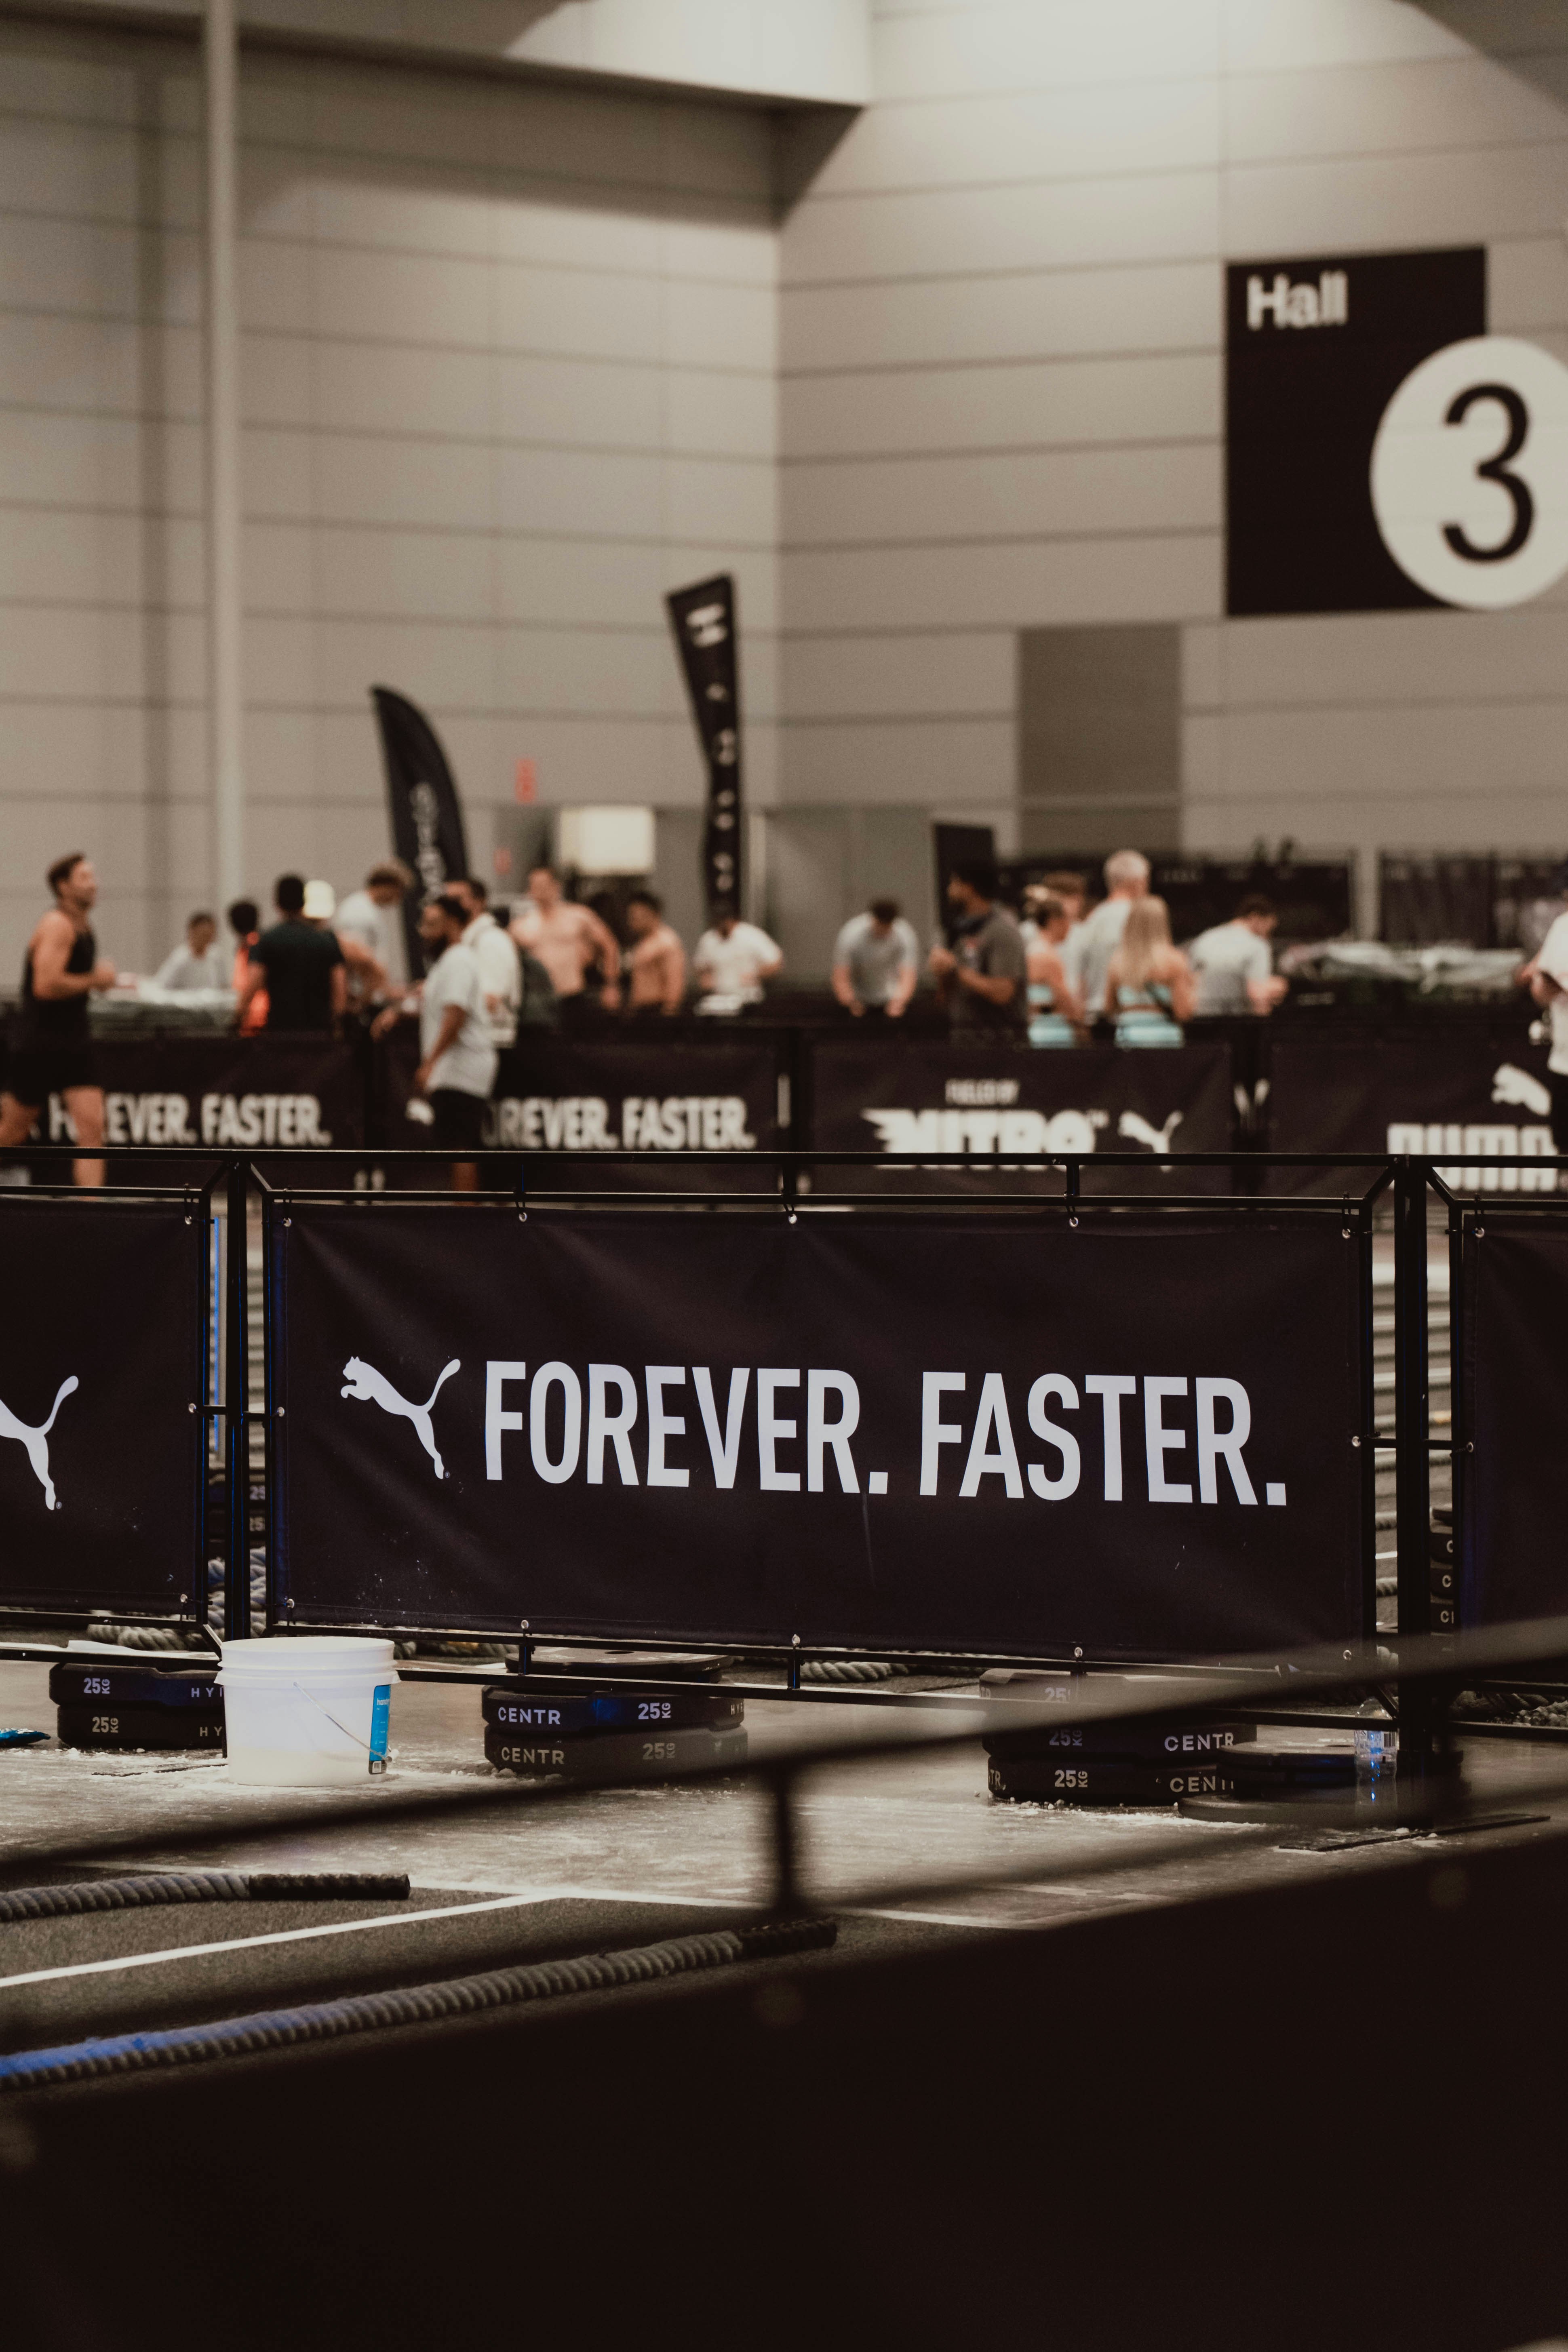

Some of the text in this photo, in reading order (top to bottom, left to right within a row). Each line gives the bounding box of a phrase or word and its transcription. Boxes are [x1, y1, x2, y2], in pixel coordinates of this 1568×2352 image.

[1246, 270, 1349, 330] Hall
[1442, 381, 1534, 563] 3
[200, 1092, 333, 1147] FASTER.
[622, 1096, 758, 1151] FASTER.
[485, 1361, 1287, 1506] FOREVER. FASTER.
[498, 1707, 561, 1725] CENTR
[1164, 1732, 1234, 1751] CENTR
[501, 1747, 564, 1764] CENTR
